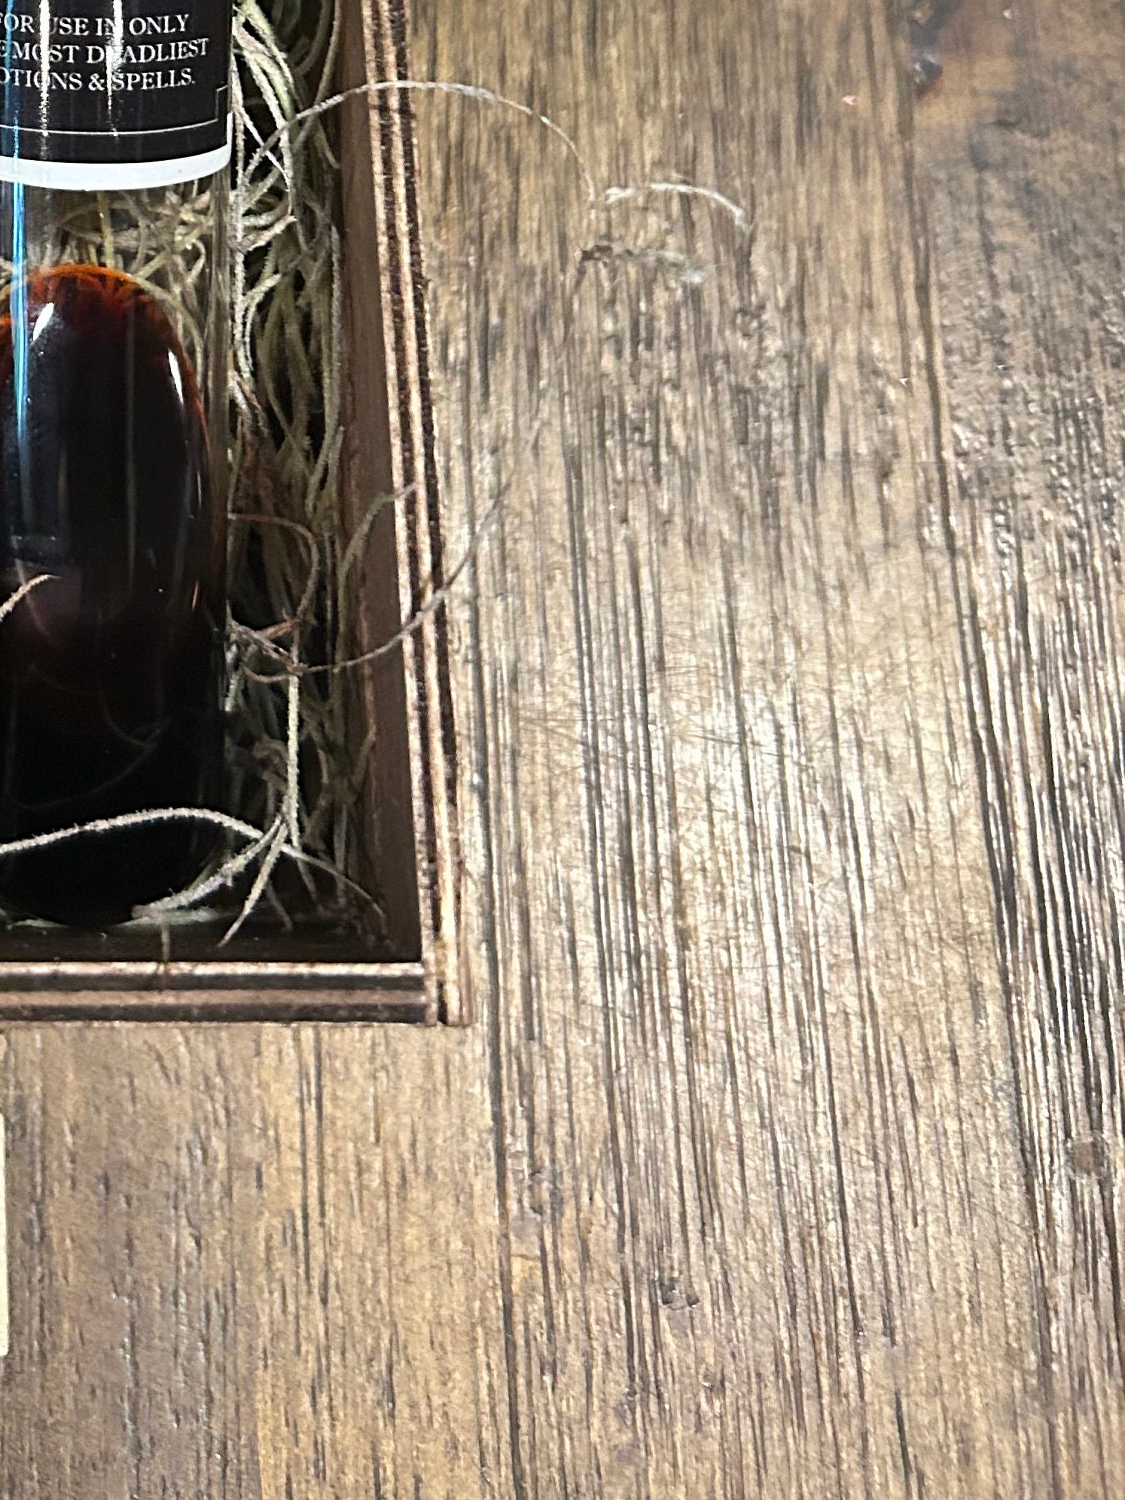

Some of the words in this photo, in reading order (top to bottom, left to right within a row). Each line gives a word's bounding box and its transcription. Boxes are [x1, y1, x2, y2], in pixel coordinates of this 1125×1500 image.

[95, 18, 124, 37] IN
[128, 13, 190, 36] ONLY
[88, 72, 106, 91] &
[111, 67, 196, 91] SPELLS.
